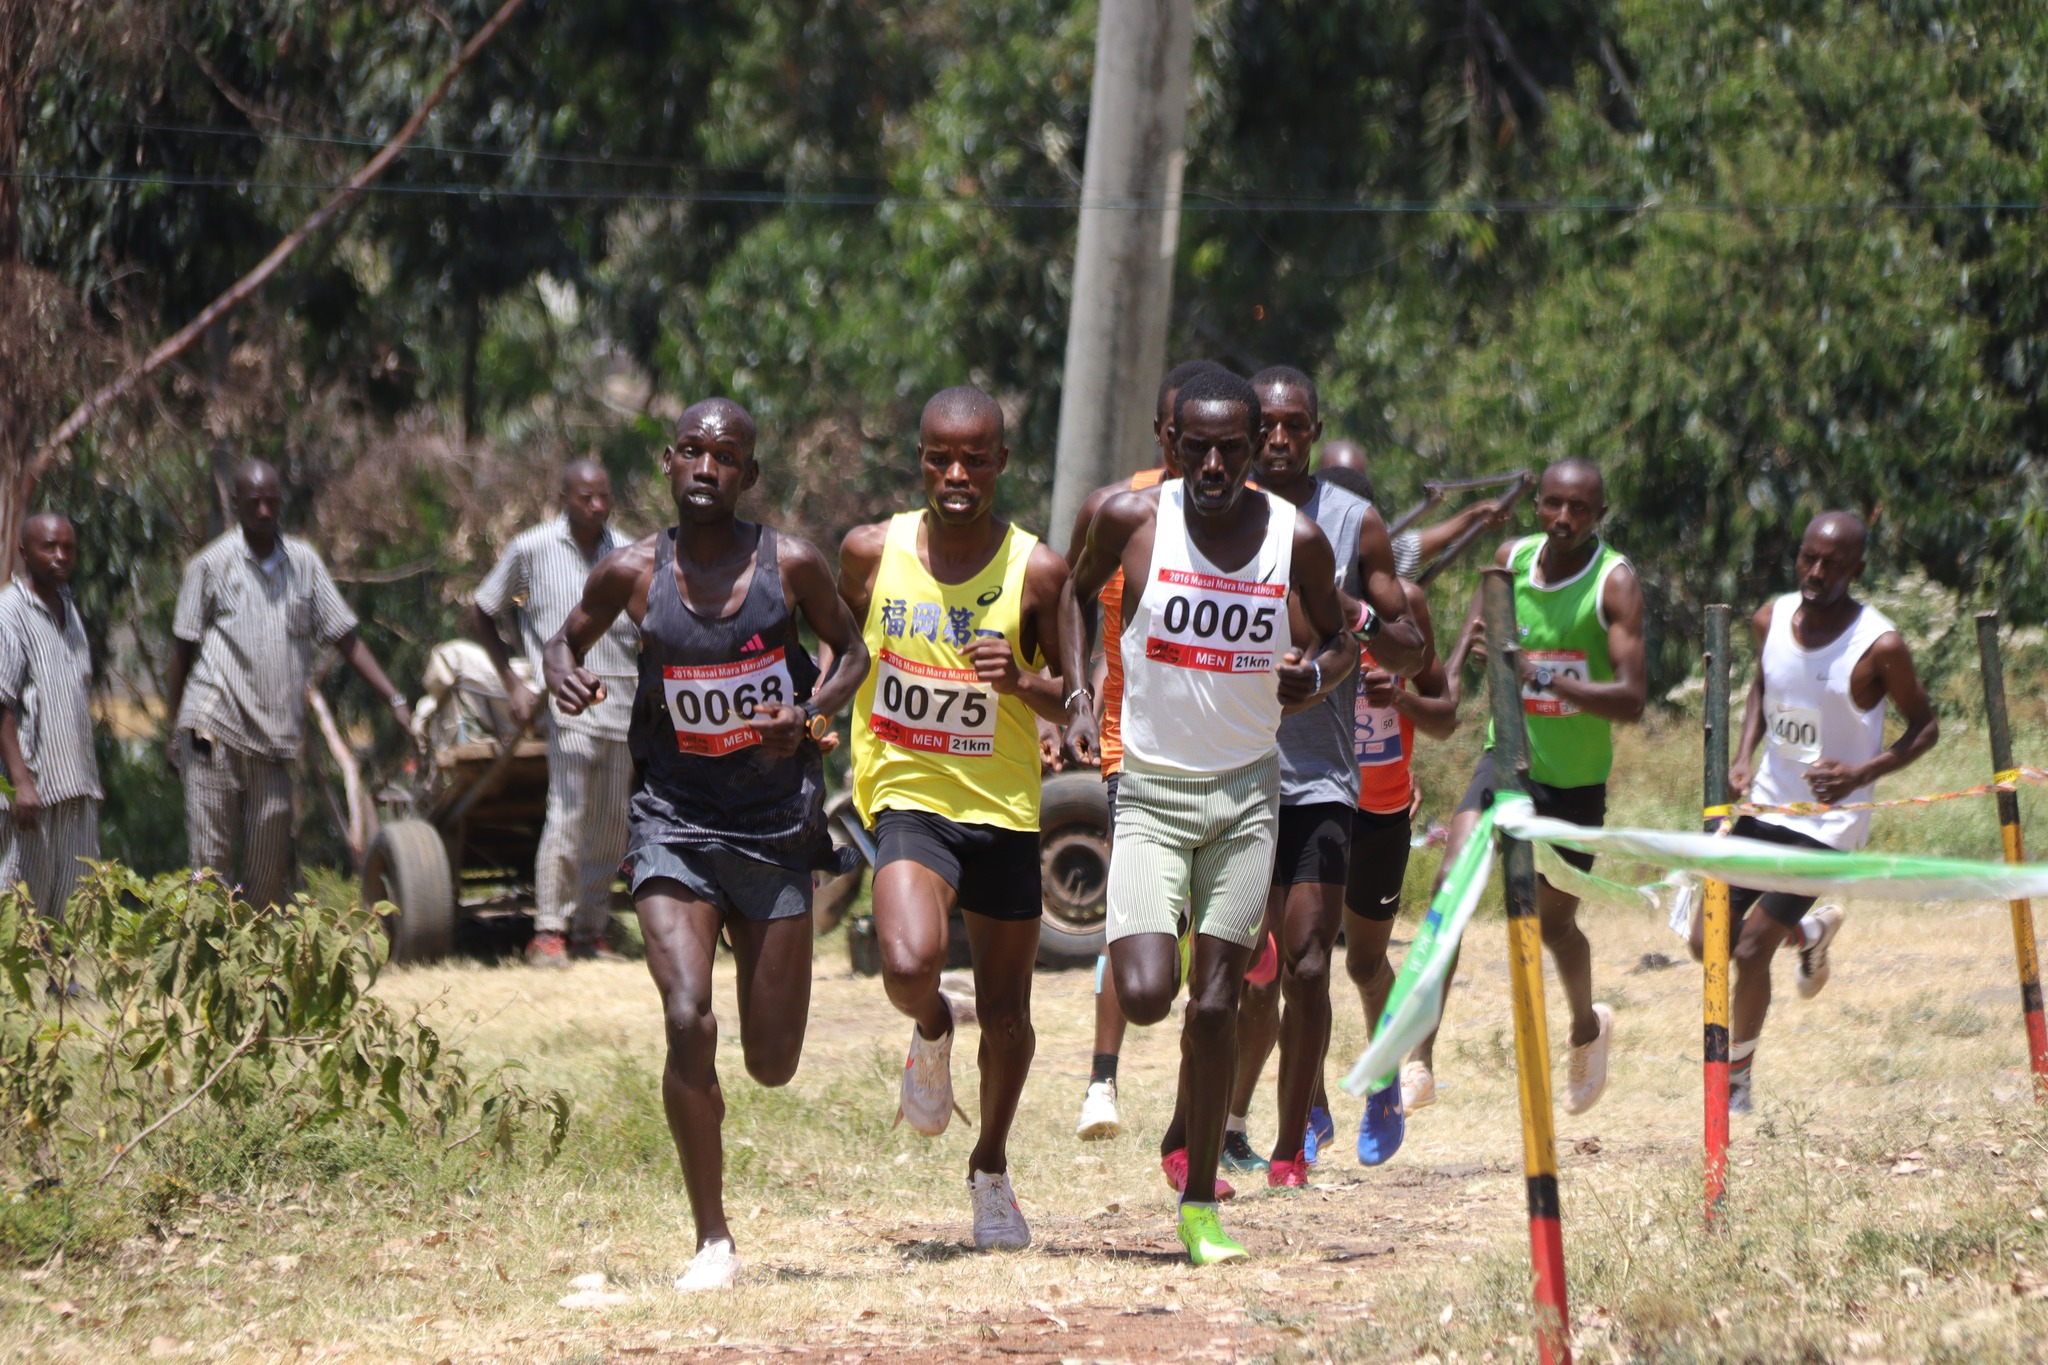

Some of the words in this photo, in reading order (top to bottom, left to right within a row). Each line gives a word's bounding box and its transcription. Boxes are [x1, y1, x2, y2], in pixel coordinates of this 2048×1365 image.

[1169, 572, 1189, 584] 2016
[1190, 574, 1215, 588] Masai
[1216, 579, 1236, 591] Mara
[1237, 582, 1276, 596] Marathon
[1163, 595, 1276, 643] 0005
[673, 669, 691, 678] 2016
[693, 670, 717, 679] Masai
[719, 668, 740, 677] Mara
[741, 654, 775, 673] Marathon
[888, 655, 903, 668] 2016
[903, 662, 925, 674] Masai
[926, 666, 947, 678] Mara
[949, 670, 978, 681] Marath
[1195, 652, 1227, 667] MEN
[1235, 656, 1270, 668] 21km
[676, 675, 783, 726] 0068
[884, 675, 987, 728] 0075
[1383, 718, 1393, 730] 50
[723, 731, 753, 748] MEN
[912, 733, 943, 748] MEN
[952, 738, 990, 751] 21km
